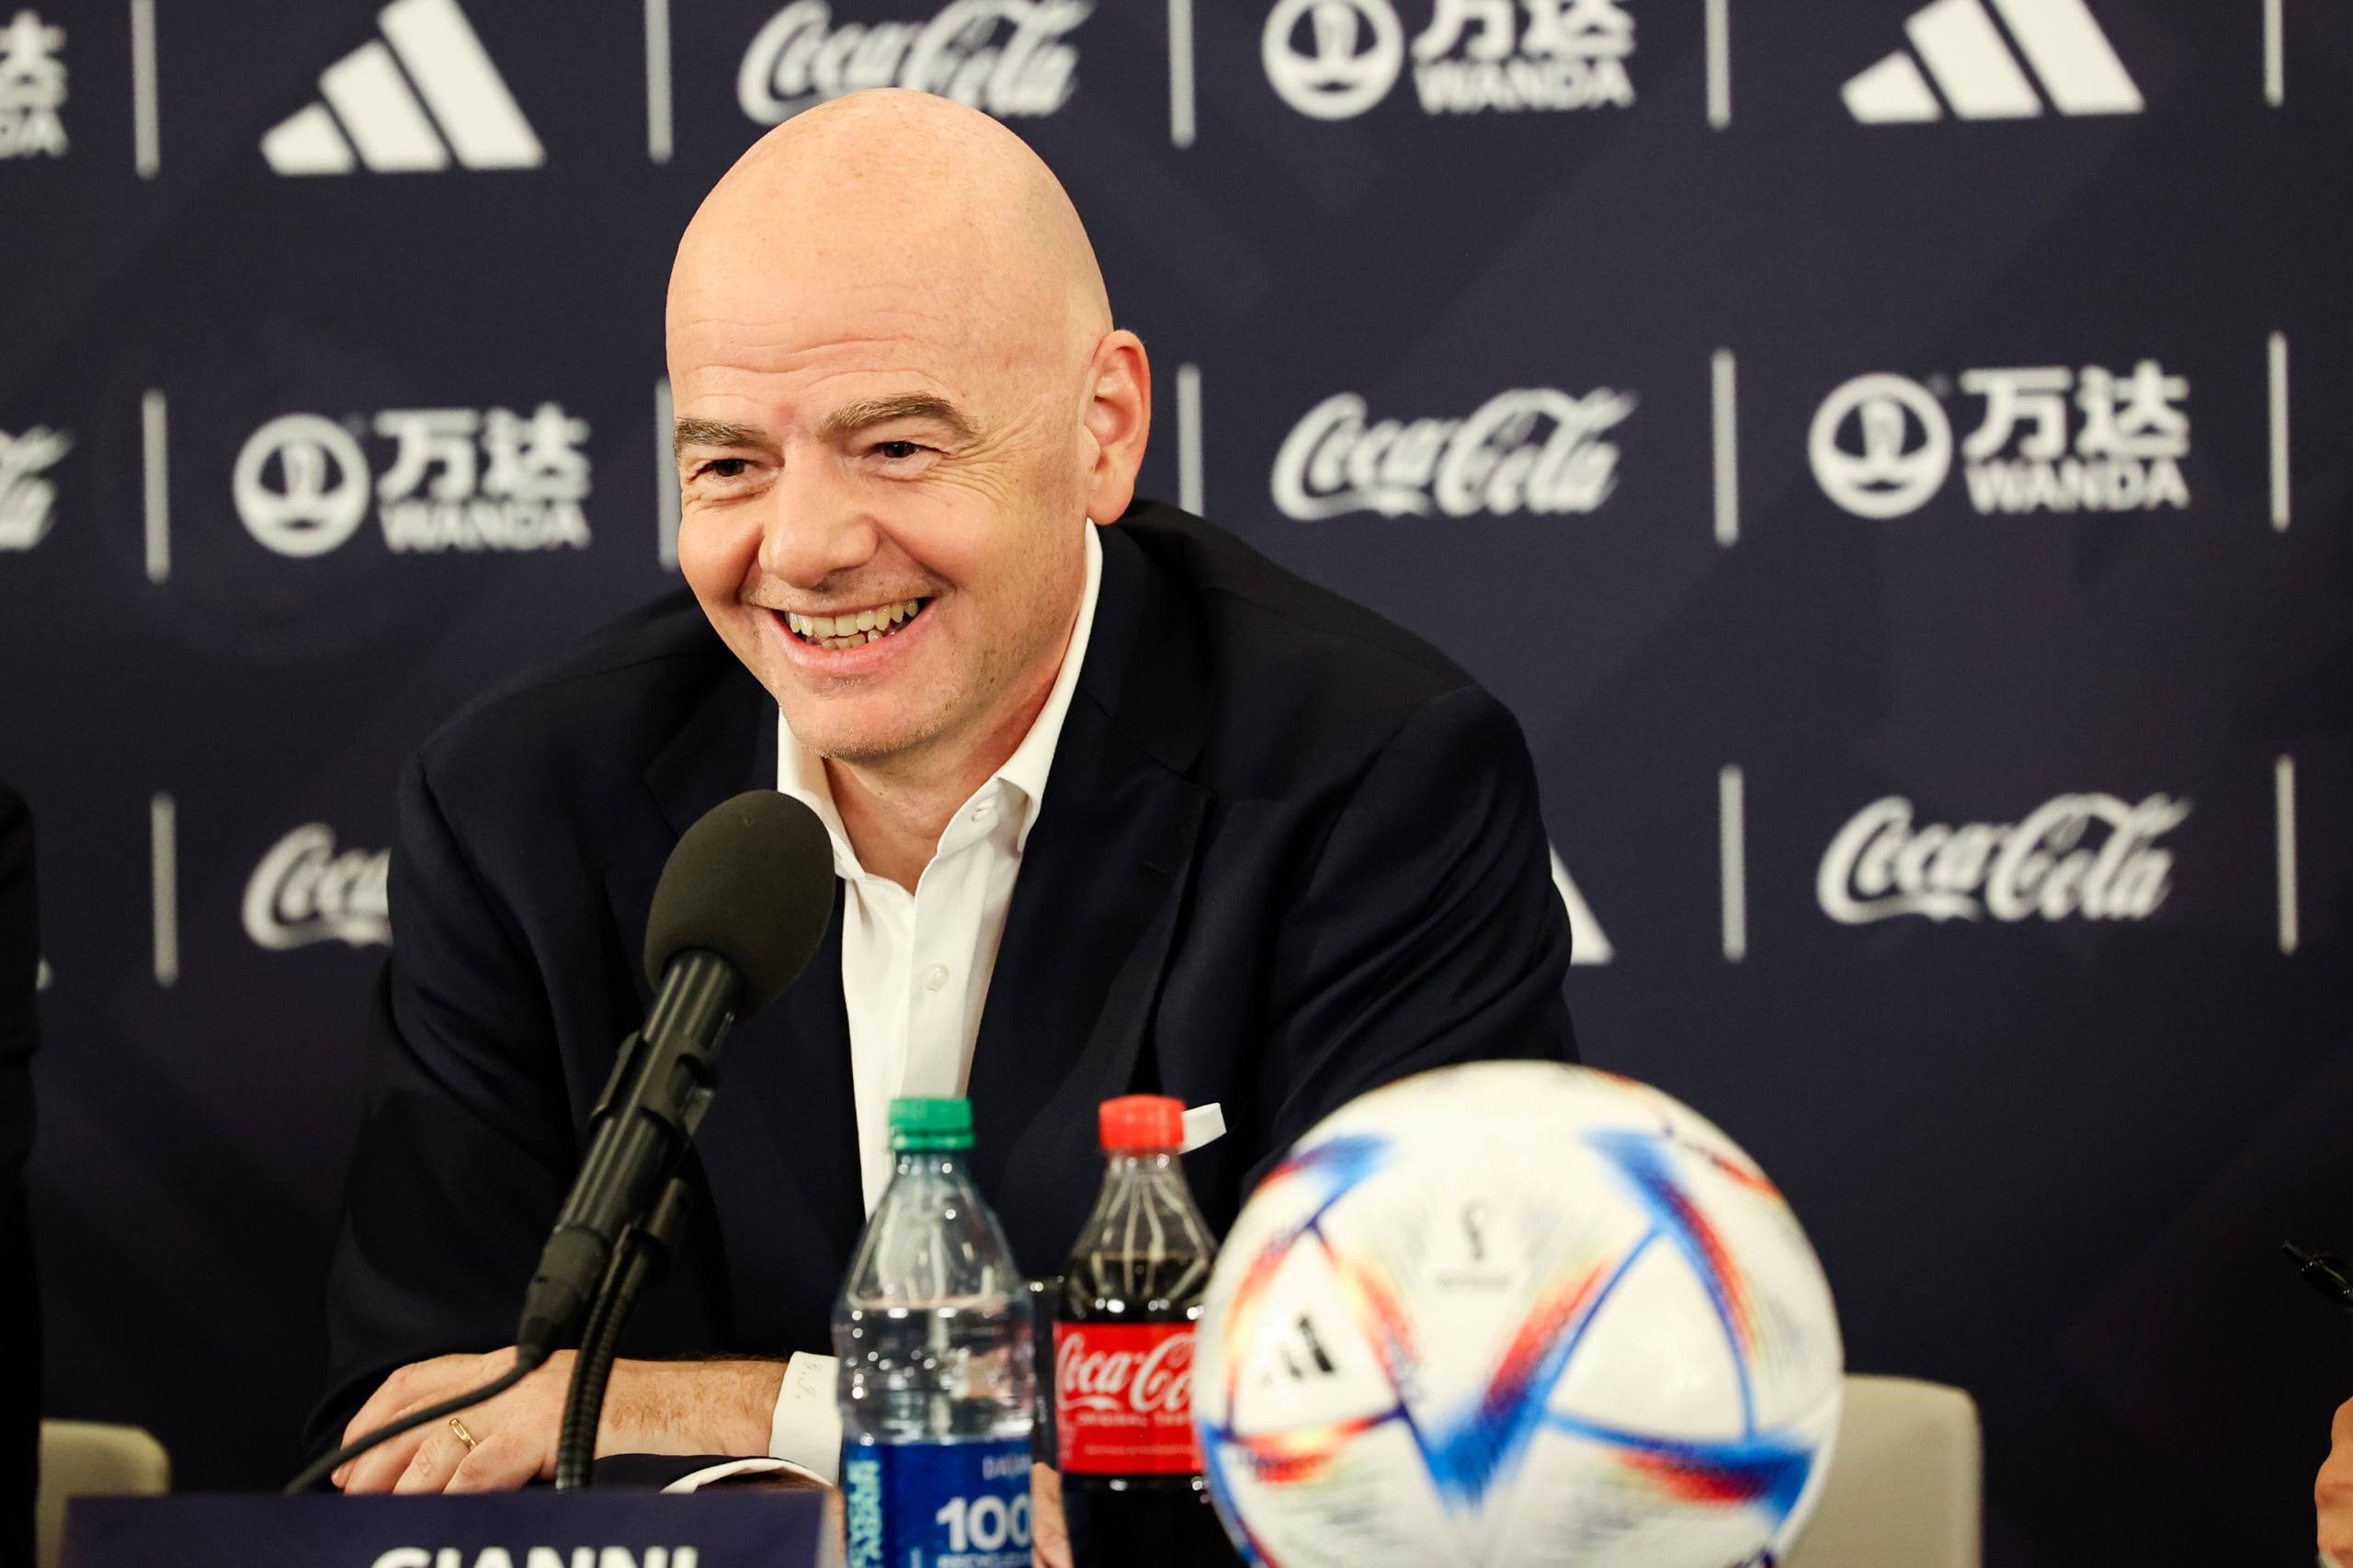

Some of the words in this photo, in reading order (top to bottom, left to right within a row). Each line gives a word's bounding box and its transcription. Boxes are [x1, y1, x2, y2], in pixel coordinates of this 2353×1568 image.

[1414, 57, 1636, 115] WANDA
[1959, 359, 2190, 460] 万达
[373, 402, 591, 502] 万达
[1963, 458, 2190, 515] WANDA
[379, 499, 591, 552] WANDA
[1056, 1332, 1195, 1413] Coca-Co
